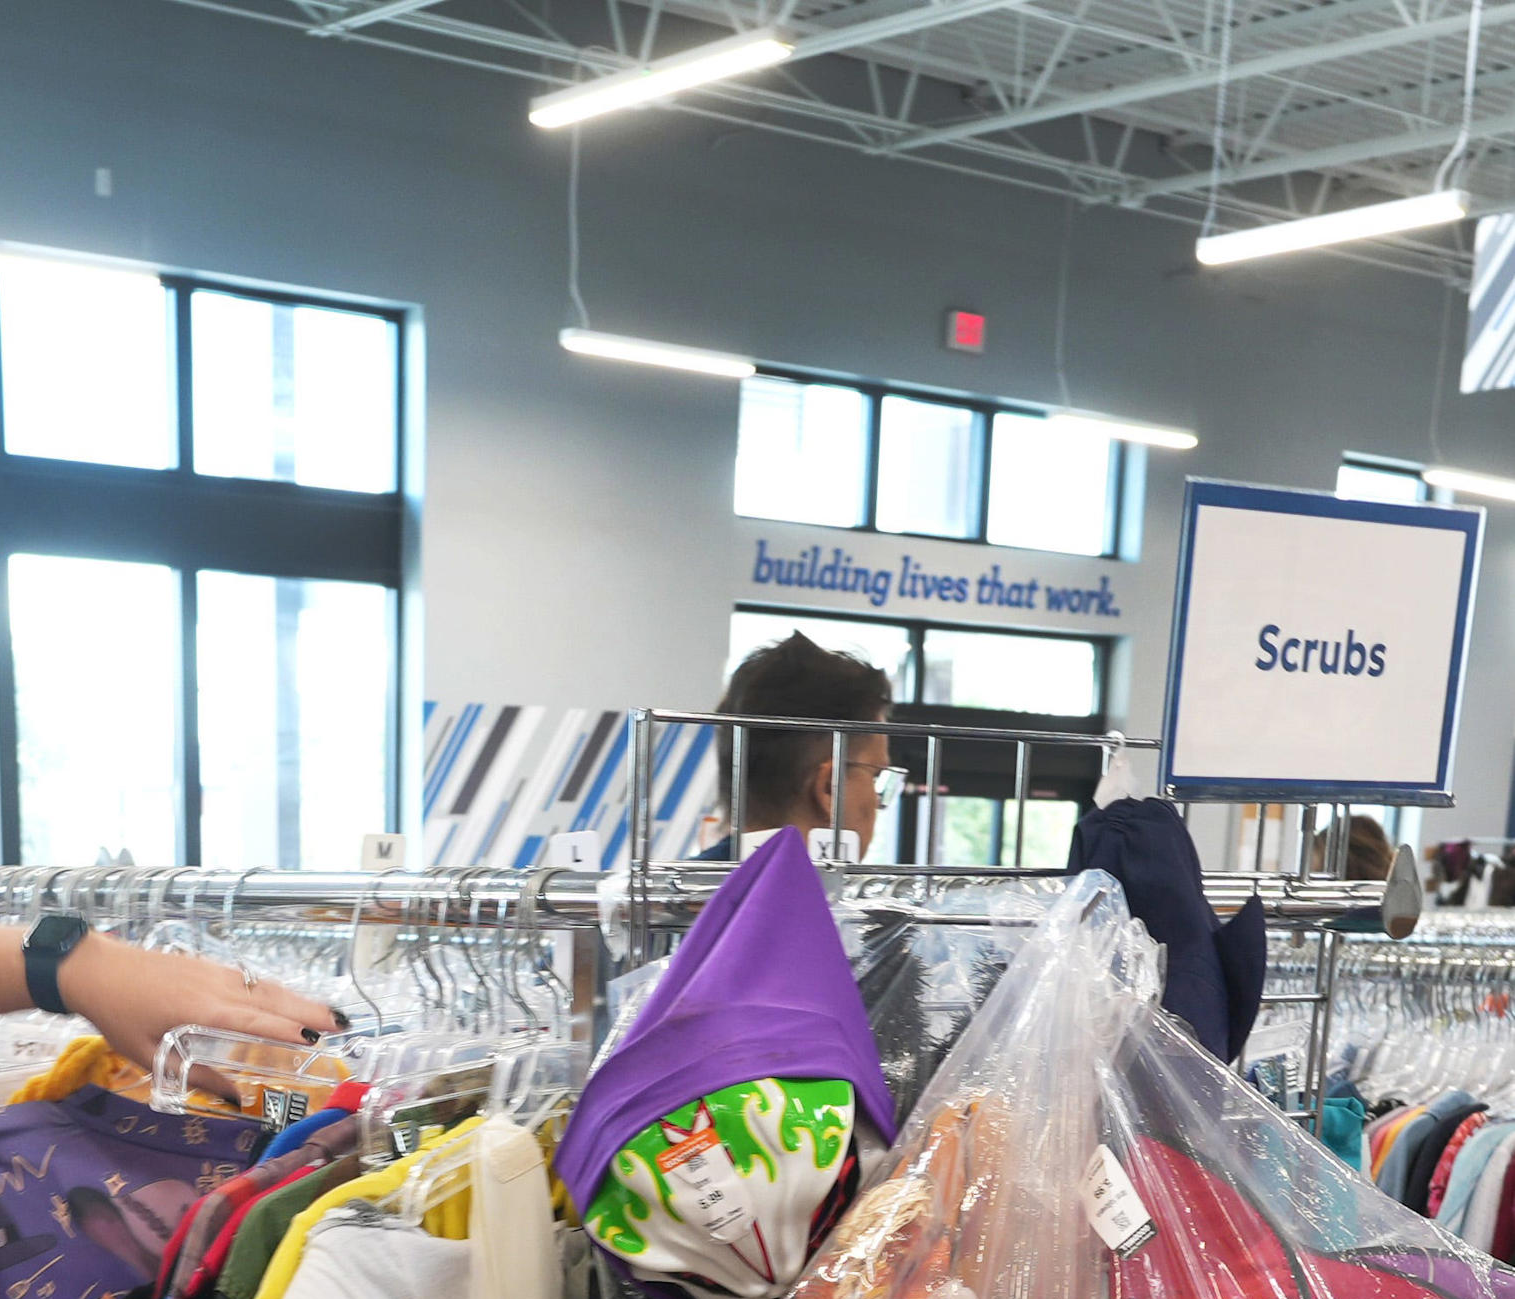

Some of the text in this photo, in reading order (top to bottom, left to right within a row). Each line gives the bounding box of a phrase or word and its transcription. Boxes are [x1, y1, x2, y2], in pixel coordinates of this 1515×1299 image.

[753, 540, 1121, 618] building lives that work.
[1255, 623, 1387, 678] Scrubs
